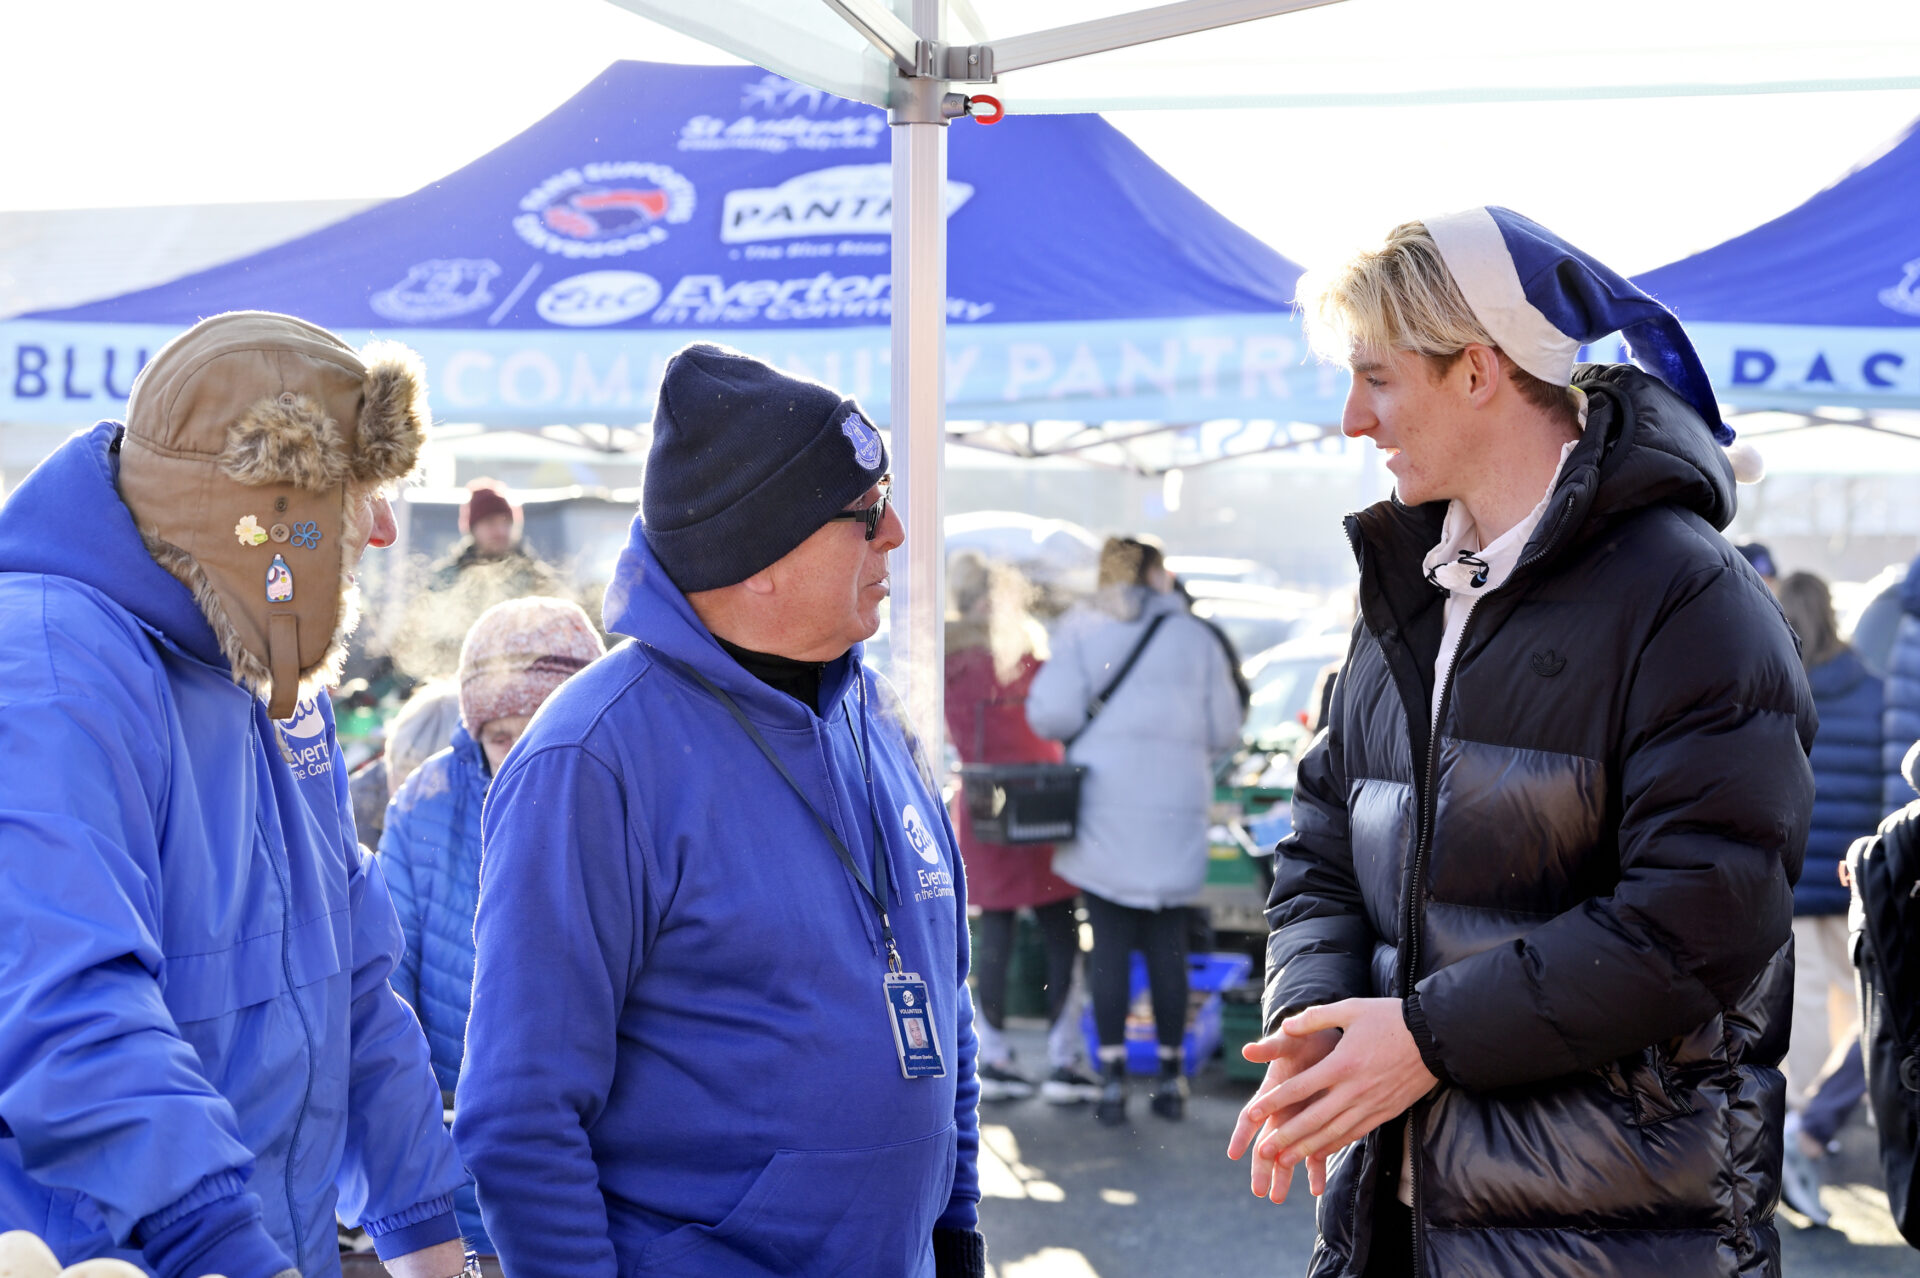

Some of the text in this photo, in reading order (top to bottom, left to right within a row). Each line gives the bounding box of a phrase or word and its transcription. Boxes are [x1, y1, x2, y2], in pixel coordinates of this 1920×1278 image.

[765, 296, 994, 322] Commity
[14, 343, 150, 399] BLU
[288, 738, 329, 769] Evert
[293, 760, 331, 781] he Com
[917, 868, 952, 888] Everto
[922, 888, 934, 900] the
